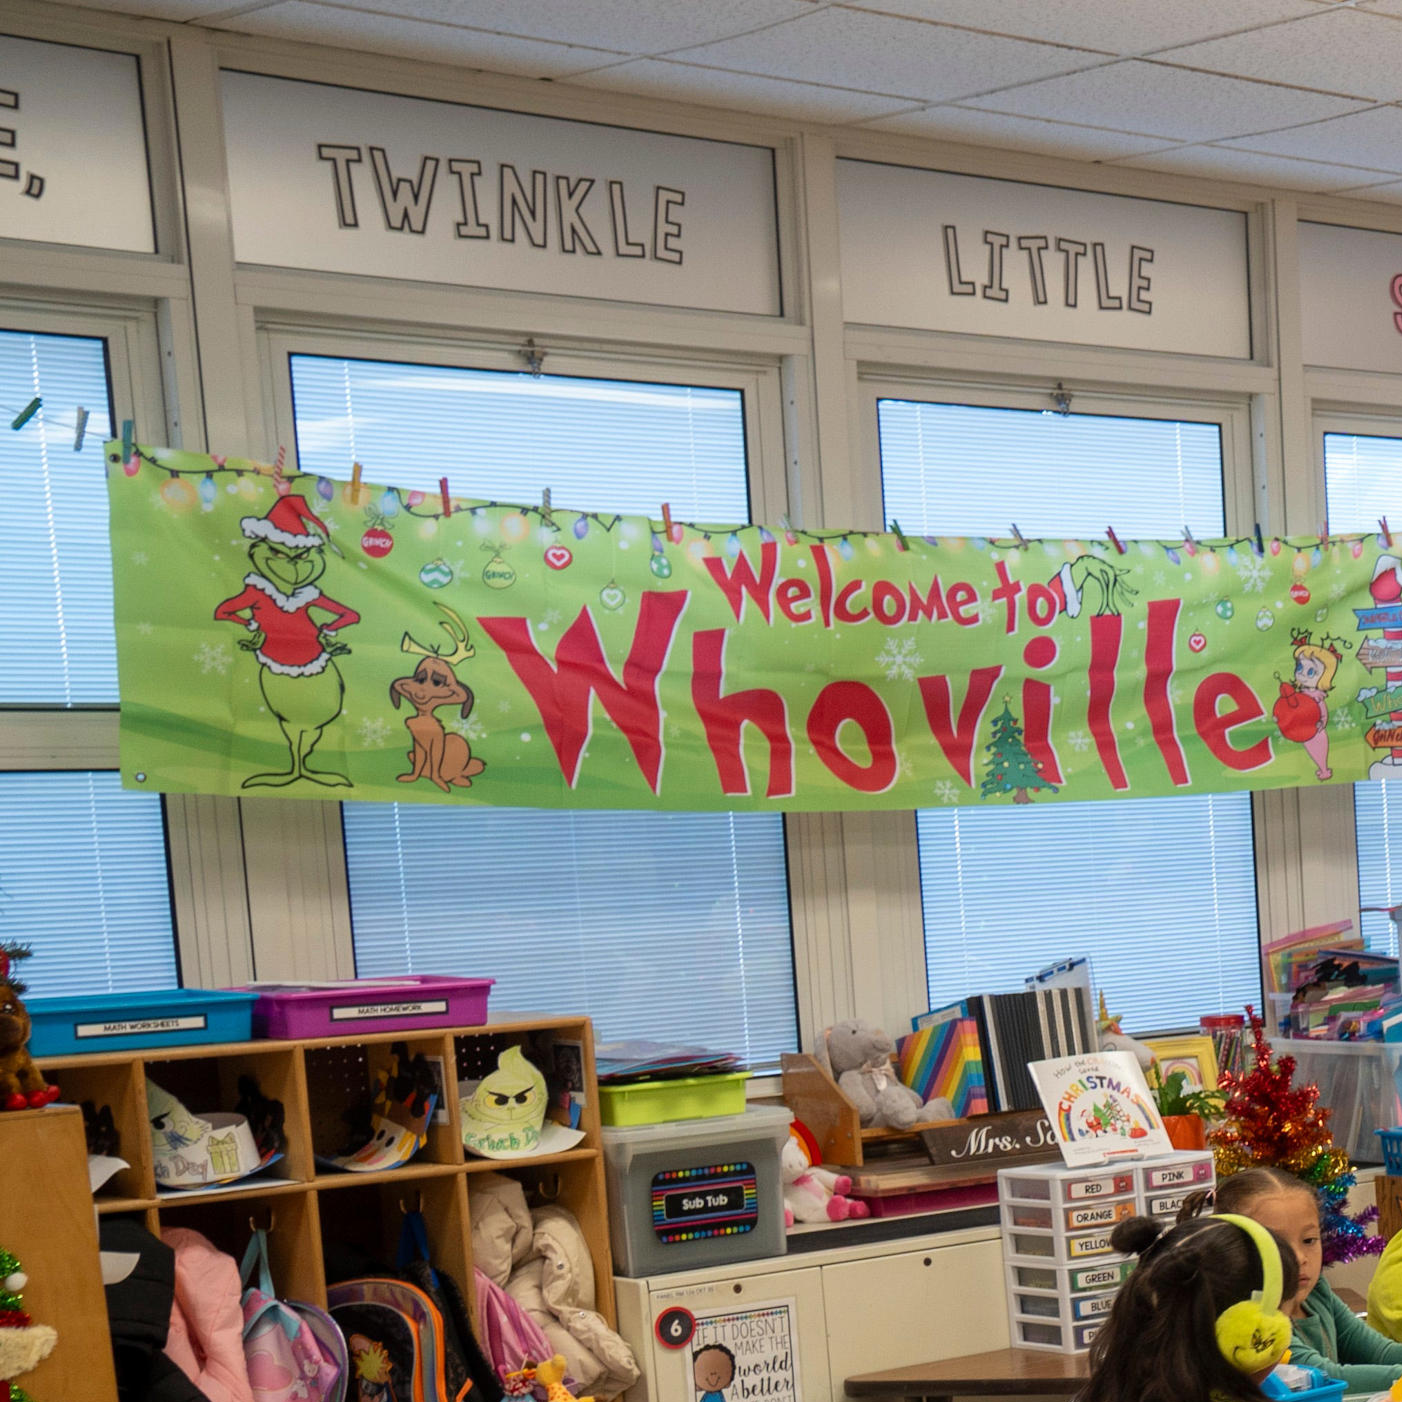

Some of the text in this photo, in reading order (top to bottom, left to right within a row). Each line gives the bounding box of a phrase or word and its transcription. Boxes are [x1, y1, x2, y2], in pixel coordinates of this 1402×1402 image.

[316, 143, 686, 265] TWINKLE
[942, 224, 1155, 314] LITTLE
[702, 541, 1062, 634] Welcome to
[476, 589, 1276, 799] Whoville
[358, 1003, 423, 1015] MATH HOMEWORK
[104, 1019, 180, 1032] MATH WORKSHEETS
[1058, 1075, 1140, 1113] CHRISTMAS
[951, 1126, 1020, 1158] Mrs.
[1162, 1171, 1185, 1182] PINK
[1085, 1184, 1102, 1194] RED
[682, 1194, 728, 1211] Sub Tub
[1159, 1200, 1183, 1211] BLAC
[1076, 1210, 1113, 1223] ORANGE
[1085, 1271, 1114, 1284] GREEN
[1091, 1300, 1112, 1312] BLUE
[670, 1319, 682, 1337] 6
[696, 1316, 785, 1346] IF IT DOESN'T
[734, 1334, 789, 1356] MAKE THE
[738, 1352, 791, 1377] world
[731, 1376, 793, 1400] A better
